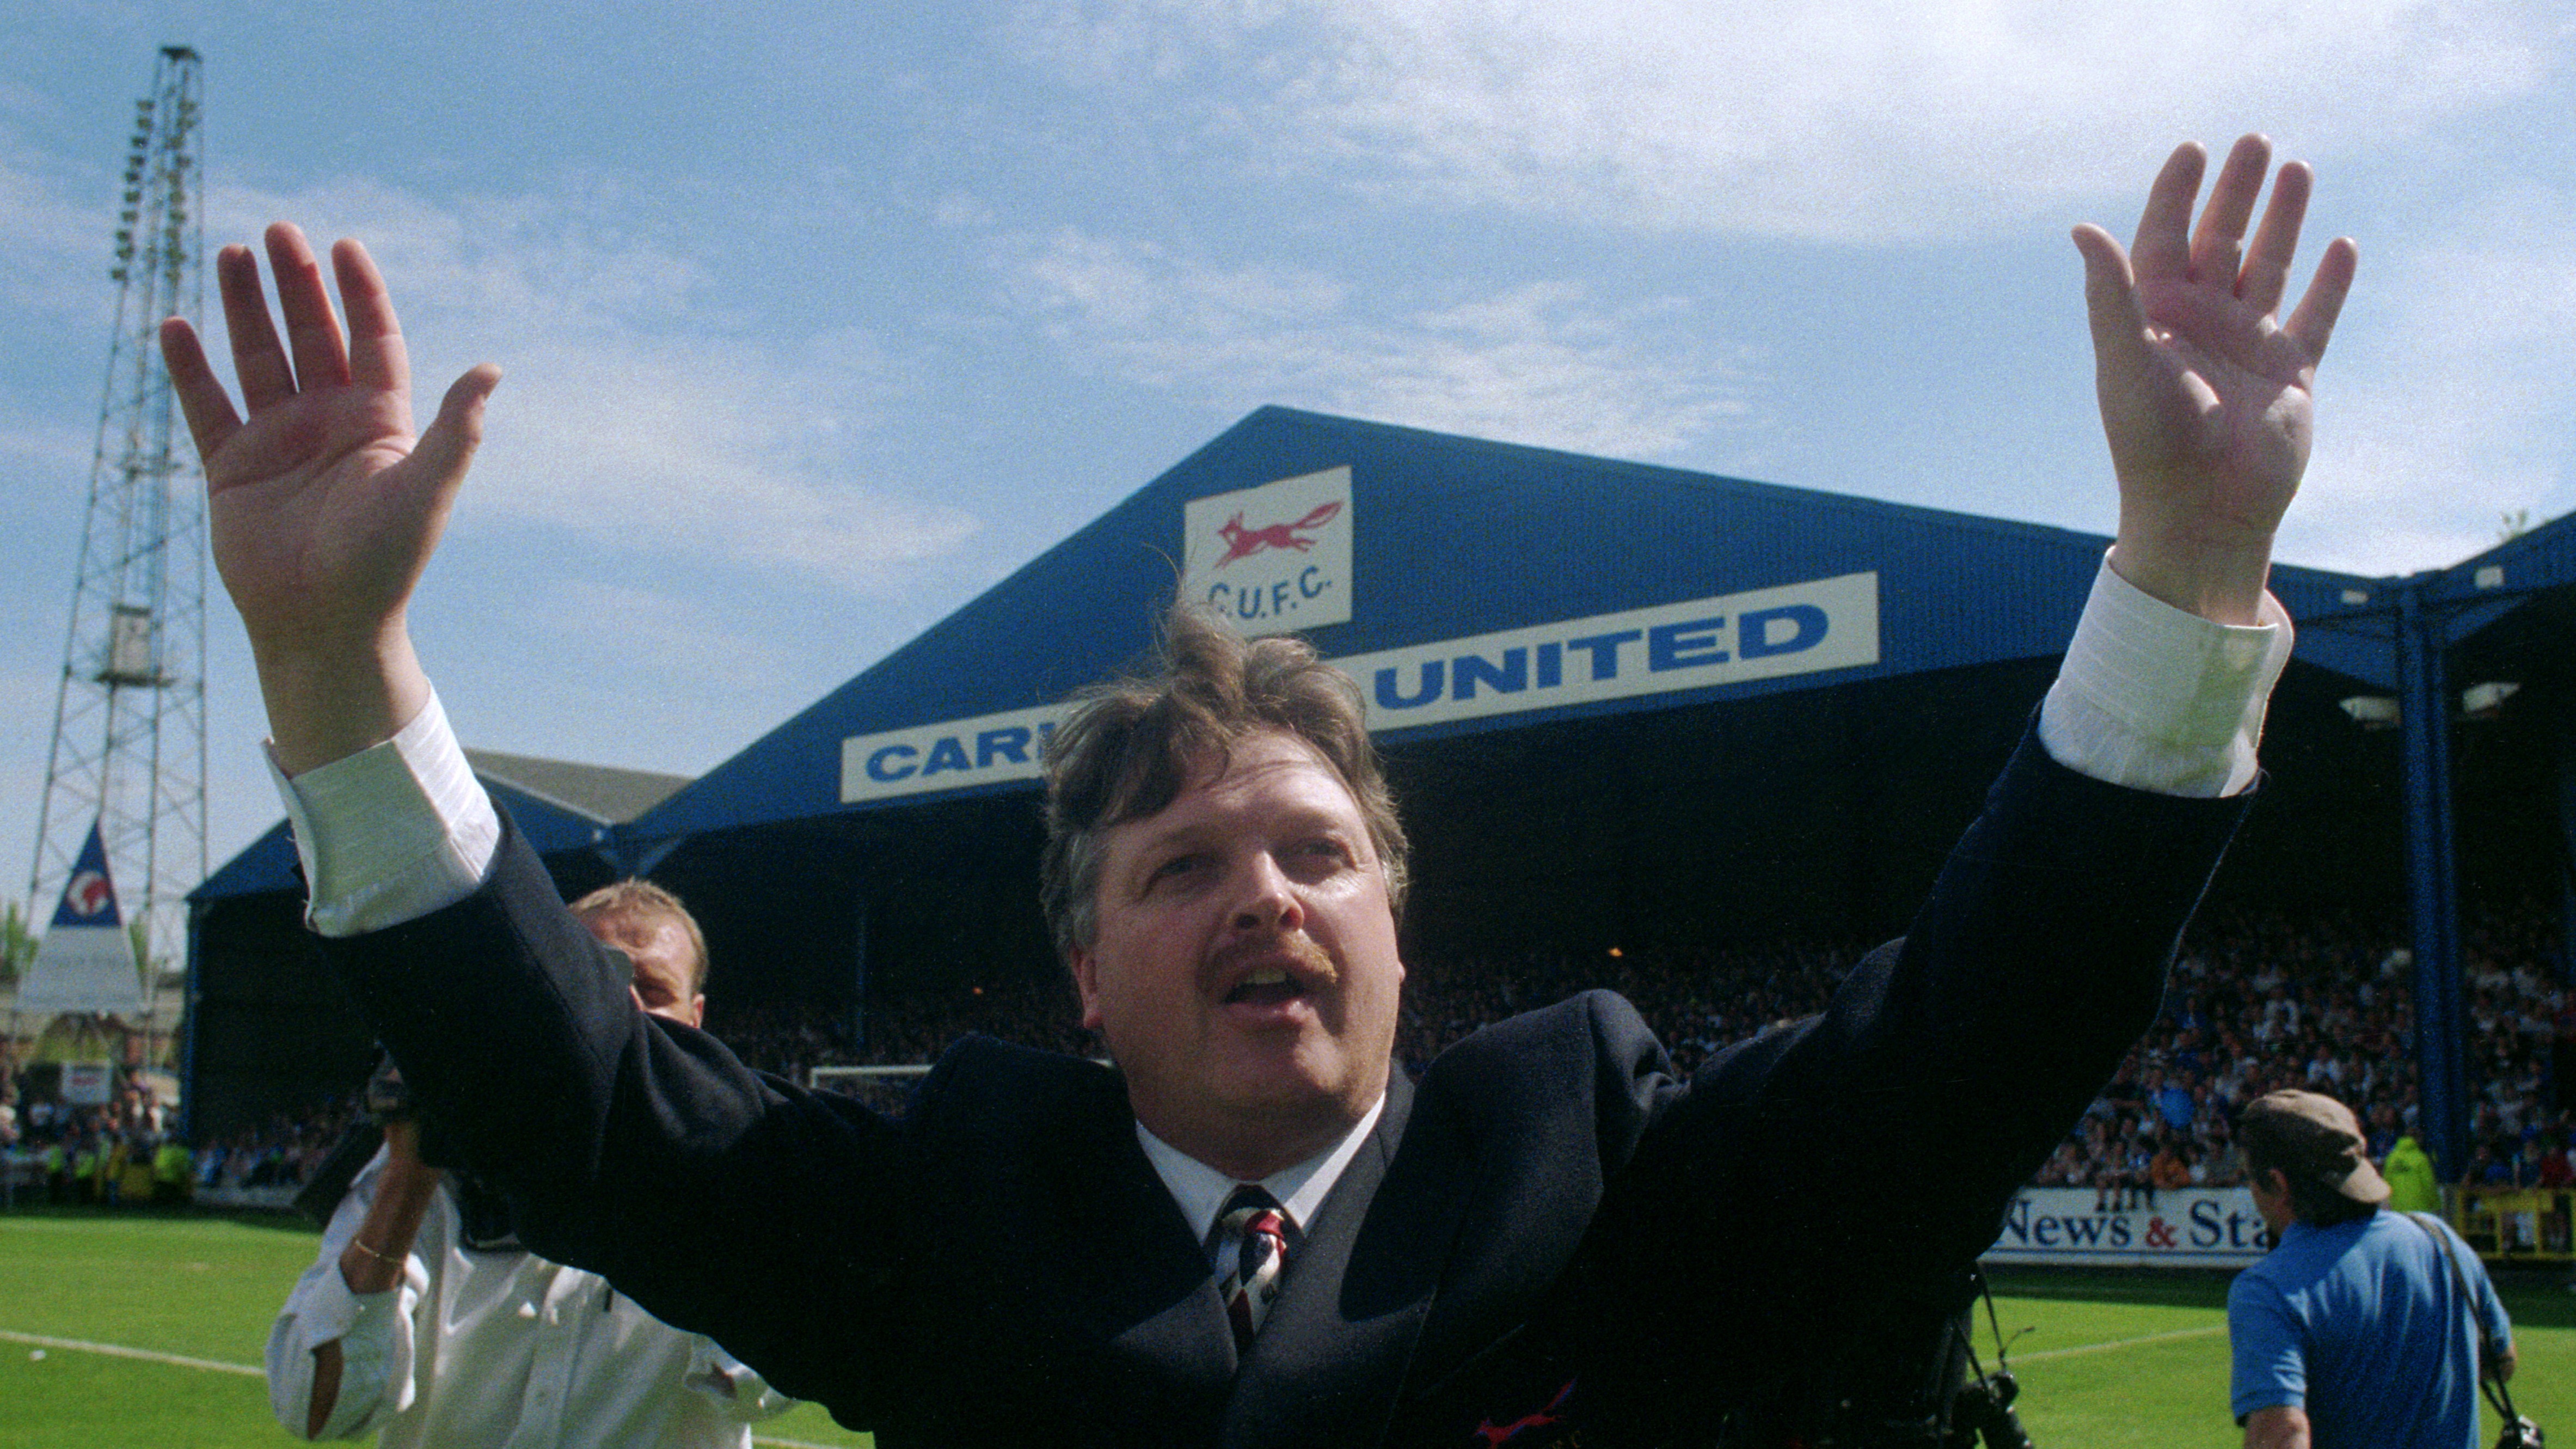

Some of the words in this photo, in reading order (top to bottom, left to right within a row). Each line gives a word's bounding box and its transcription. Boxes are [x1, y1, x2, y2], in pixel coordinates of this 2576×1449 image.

[1374, 603, 1829, 710] UNITED
[1996, 1199, 2132, 1247] News
[2145, 1216, 2178, 1248] &
